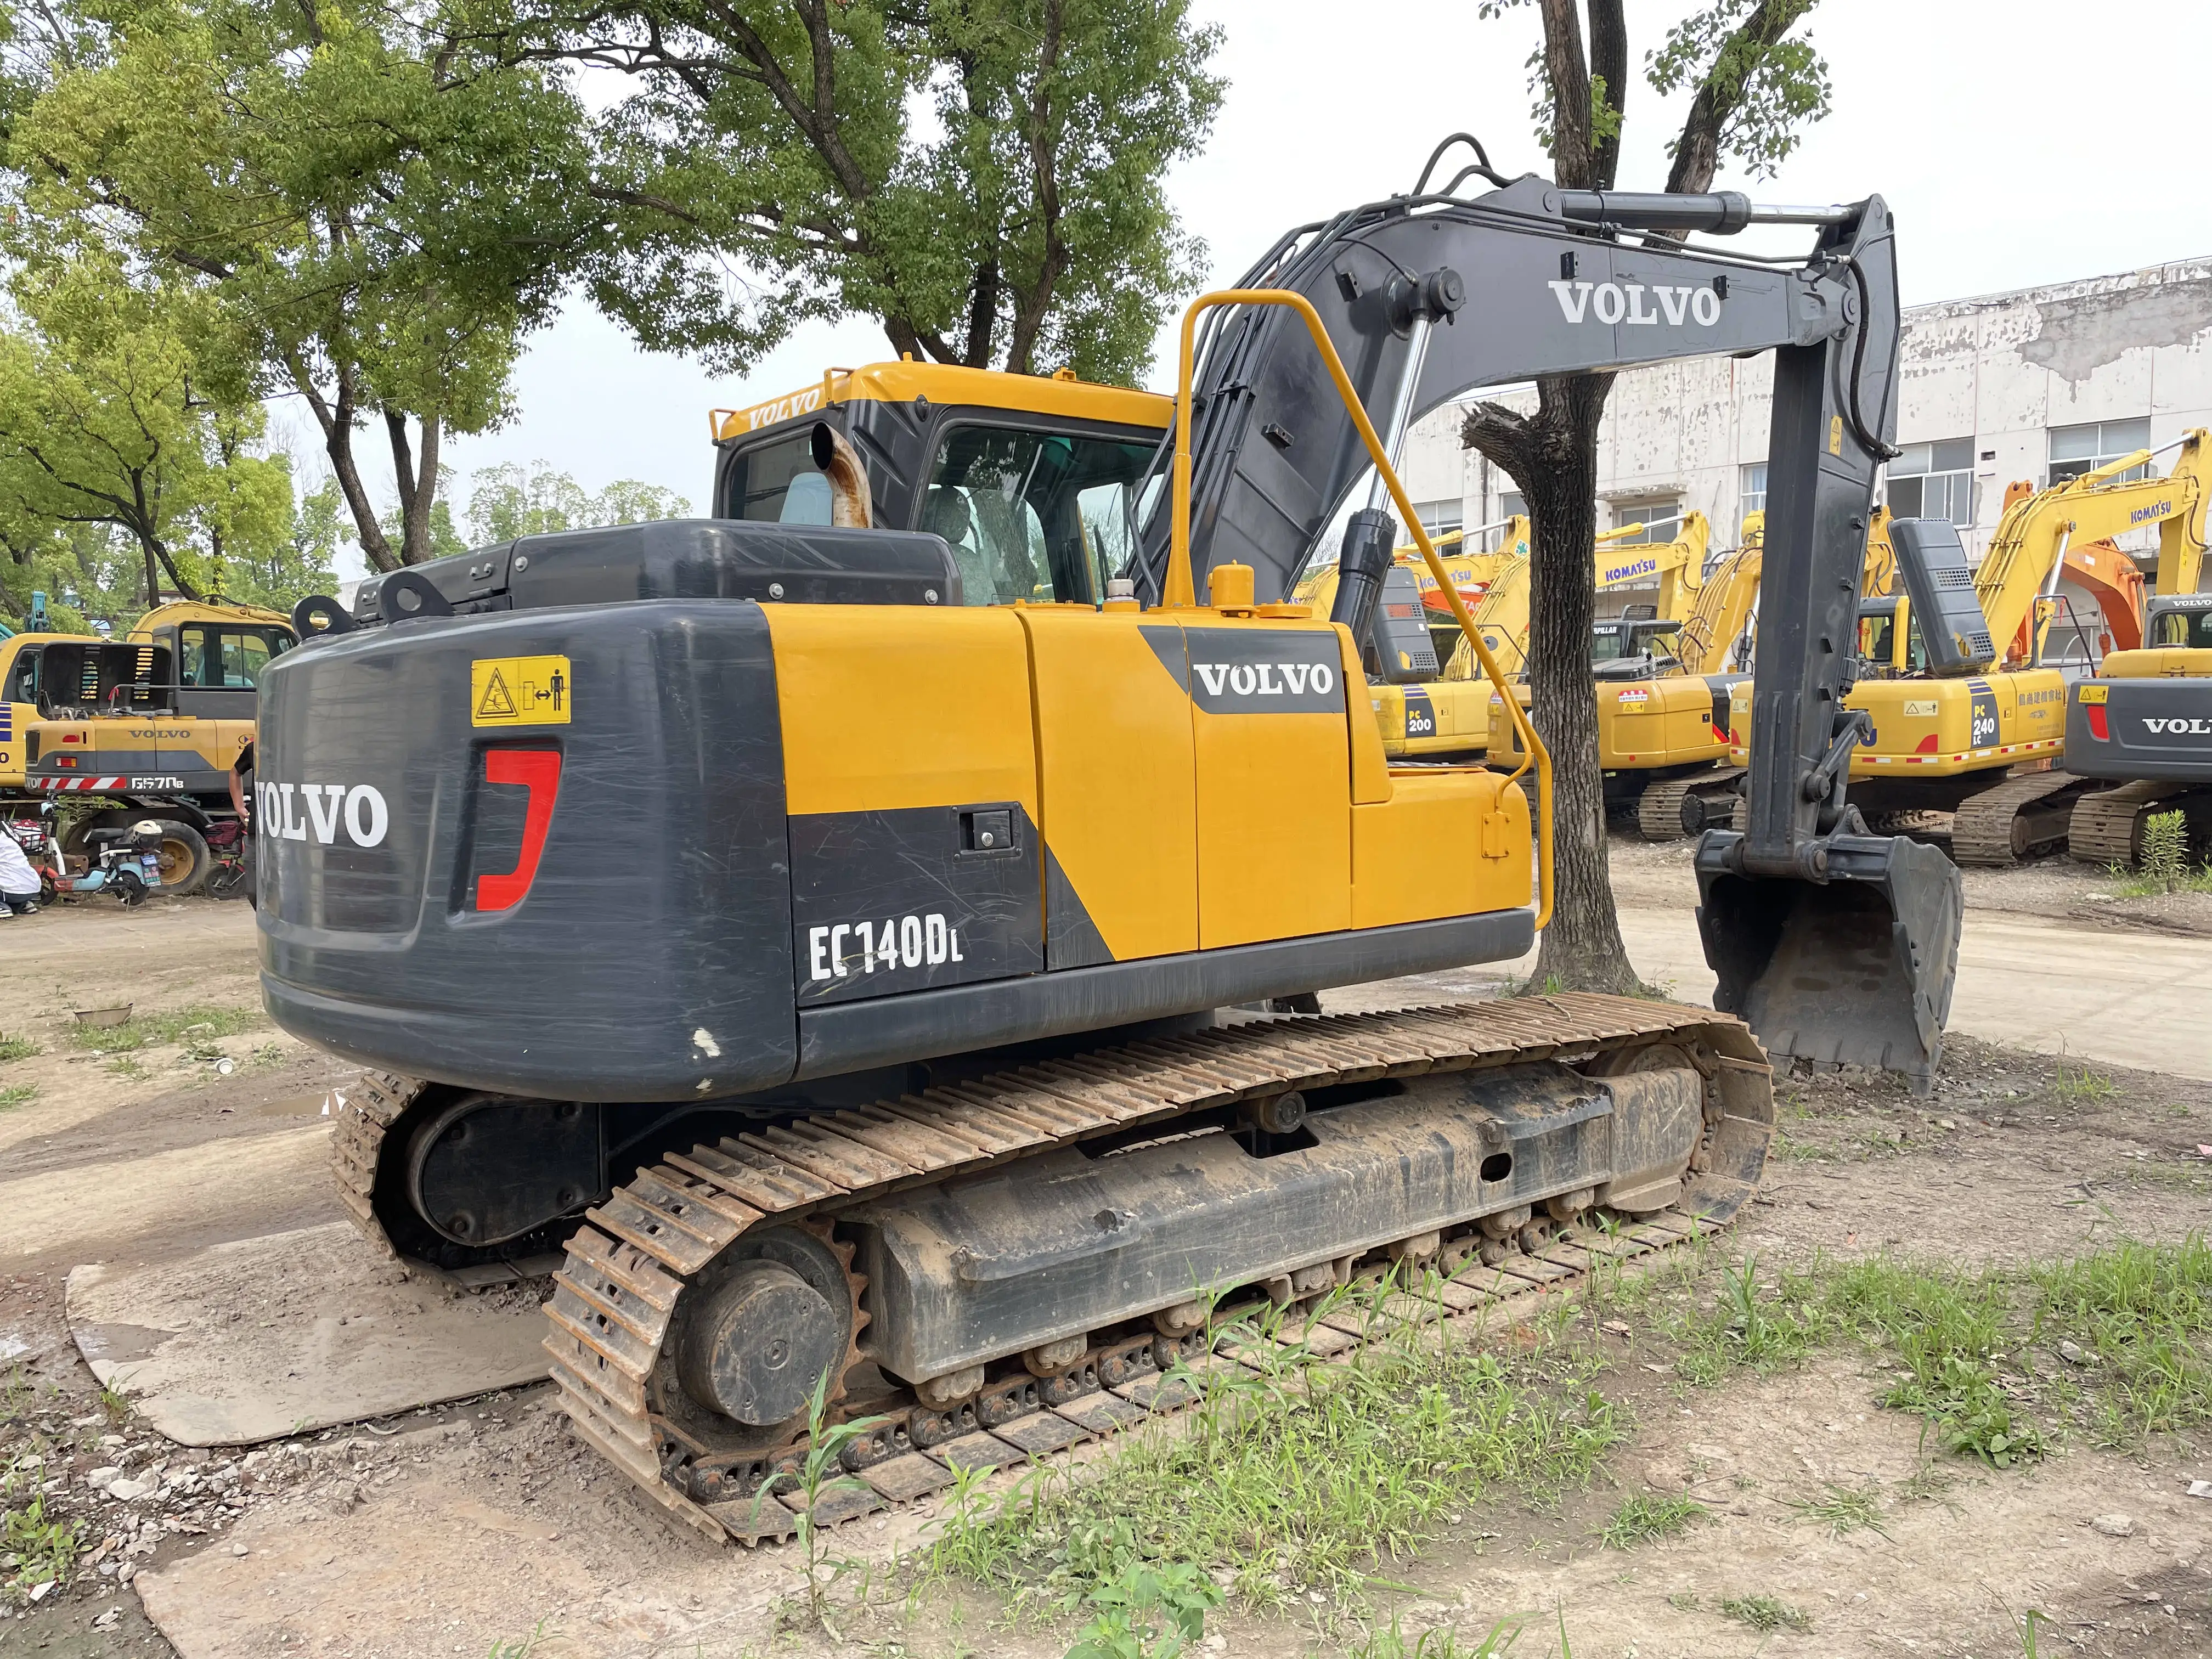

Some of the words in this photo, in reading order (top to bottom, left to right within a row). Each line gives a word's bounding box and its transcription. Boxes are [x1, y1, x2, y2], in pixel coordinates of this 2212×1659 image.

[1548, 280, 1720, 326] VOLVO
[749, 388, 820, 430] VOLVO
[2131, 500, 2171, 524] KOMATSU
[1419, 569, 1471, 589] KOTSU
[1605, 559, 1656, 582] KOMATSU
[1193, 663, 1333, 695] VOLVO
[1409, 710, 1420, 720] PC
[1974, 704, 1985, 718] PC
[1409, 719, 1431, 732] 200
[1973, 718, 1994, 735] 240
[2142, 718, 2212, 733] VOL
[1973, 735, 1981, 745] LC
[255, 782, 388, 847] VOLVO
[809, 913, 963, 980] EC140DL
